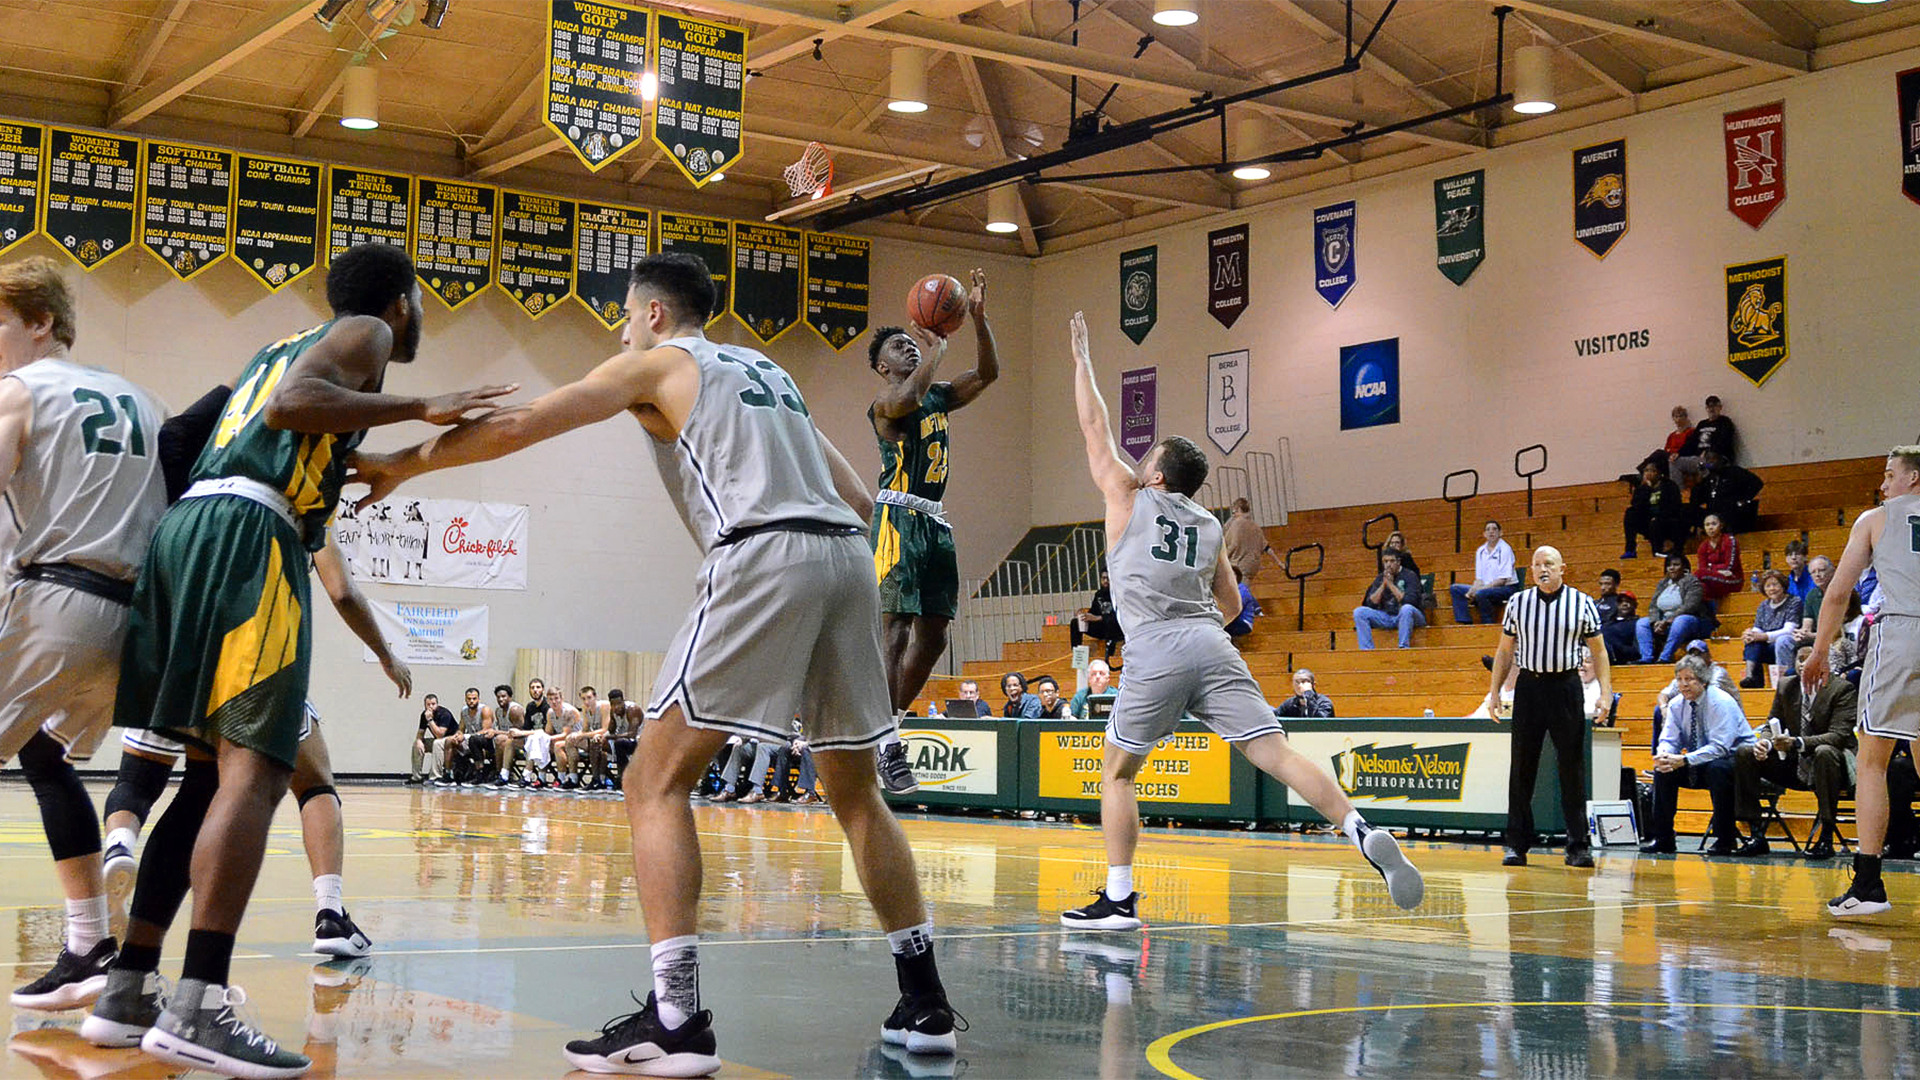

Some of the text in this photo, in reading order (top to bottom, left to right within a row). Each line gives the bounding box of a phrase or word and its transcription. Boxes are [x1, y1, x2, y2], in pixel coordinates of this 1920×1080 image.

[573, 1, 628, 21] WOMEN'S
[581, 12, 619, 29] GOLF
[553, 20, 645, 46] NGCA NAT. CHAMPS
[678, 20, 726, 39] WOMEN'S
[684, 31, 719, 46] GOLF
[660, 37, 743, 62] NCAA APPEARANCES
[552, 57, 577, 70] NCAA
[580, 62, 642, 80] APPEARANCE
[681, 52, 722, 69] 2004 2005
[552, 72, 574, 85] NCAA
[575, 77, 594, 89] NAT.
[602, 74, 620, 85] 2001
[681, 70, 699, 81] 2012
[705, 75, 721, 86] 2013
[550, 92, 642, 117] NCAA NAT. CHAMPS
[659, 97, 742, 121] NCAA NAT. CHAMPS
[550, 112, 568, 124] 2001
[574, 117, 594, 128] 2002
[597, 121, 617, 133] 2003
[702, 116, 720, 127] 2007
[1726, 113, 1782, 131] HUNTINGDON
[681, 121, 739, 139] 2010 2011 2012
[69, 142, 120, 157] SOCCER
[71, 134, 120, 149] WOMEN'S
[60, 151, 129, 168] CONF. CHAMPS
[158, 145, 222, 162] SOFTBALL
[1581, 148, 1619, 165] AVERETT
[156, 156, 223, 171] CONF. CHAMPS
[248, 160, 310, 177] SOFTBALL
[246, 170, 311, 186] CONF. CHAMPS
[356, 173, 386, 184] MEN'S
[348, 179, 393, 194] TENNIS
[436, 183, 479, 196] WOMEN'S
[1446, 186, 1472, 200] PEACE
[101, 199, 133, 211] CHAMPS
[366, 192, 401, 203] CHAMPS
[435, 190, 478, 204] TENNIS
[1735, 190, 1775, 206] COLLEGE
[197, 203, 227, 214] CHAMPS
[287, 204, 316, 215] CHAMPS
[518, 202, 560, 215] TENNIS
[1316, 208, 1354, 223] COVENANT
[580, 212, 610, 224] TRACK
[621, 218, 647, 229] FIELD
[146, 228, 226, 244] NCAA APPEARANCES
[240, 228, 313, 245] NCAA APPEARANCES
[663, 222, 690, 233] TRACK
[702, 227, 727, 237] FIELD
[1576, 220, 1626, 239] UNIVERSITY
[1328, 240, 1341, 264] C
[1214, 251, 1242, 291] M
[1728, 265, 1783, 284] METHODIST
[1318, 274, 1348, 288] COLLEGE
[1215, 297, 1242, 309] COLLEGE
[1124, 315, 1149, 326] COLLEGE
[1574, 328, 1650, 357] VISITORS
[1729, 346, 1785, 363] UNIVERSITY
[1218, 360, 1239, 370] BEREA
[1221, 375, 1236, 401] B
[1355, 381, 1387, 399] NCAA
[72, 386, 147, 458] 21
[1215, 423, 1241, 434] COLLEGE
[1126, 435, 1151, 445] COLLEGE
[442, 519, 518, 559] Chick-fil-A
[1151, 514, 1199, 569] 31
[396, 602, 460, 618] FAIRFIELD
[406, 626, 444, 638] Marriott
[1057, 735, 1106, 750] WELC
[1174, 736, 1210, 750] THE
[1152, 760, 1190, 774] THE
[1357, 753, 1400, 774] Nelson
[1413, 753, 1461, 779] Nelson
[1357, 776, 1460, 790] CHIROPRACTIC
